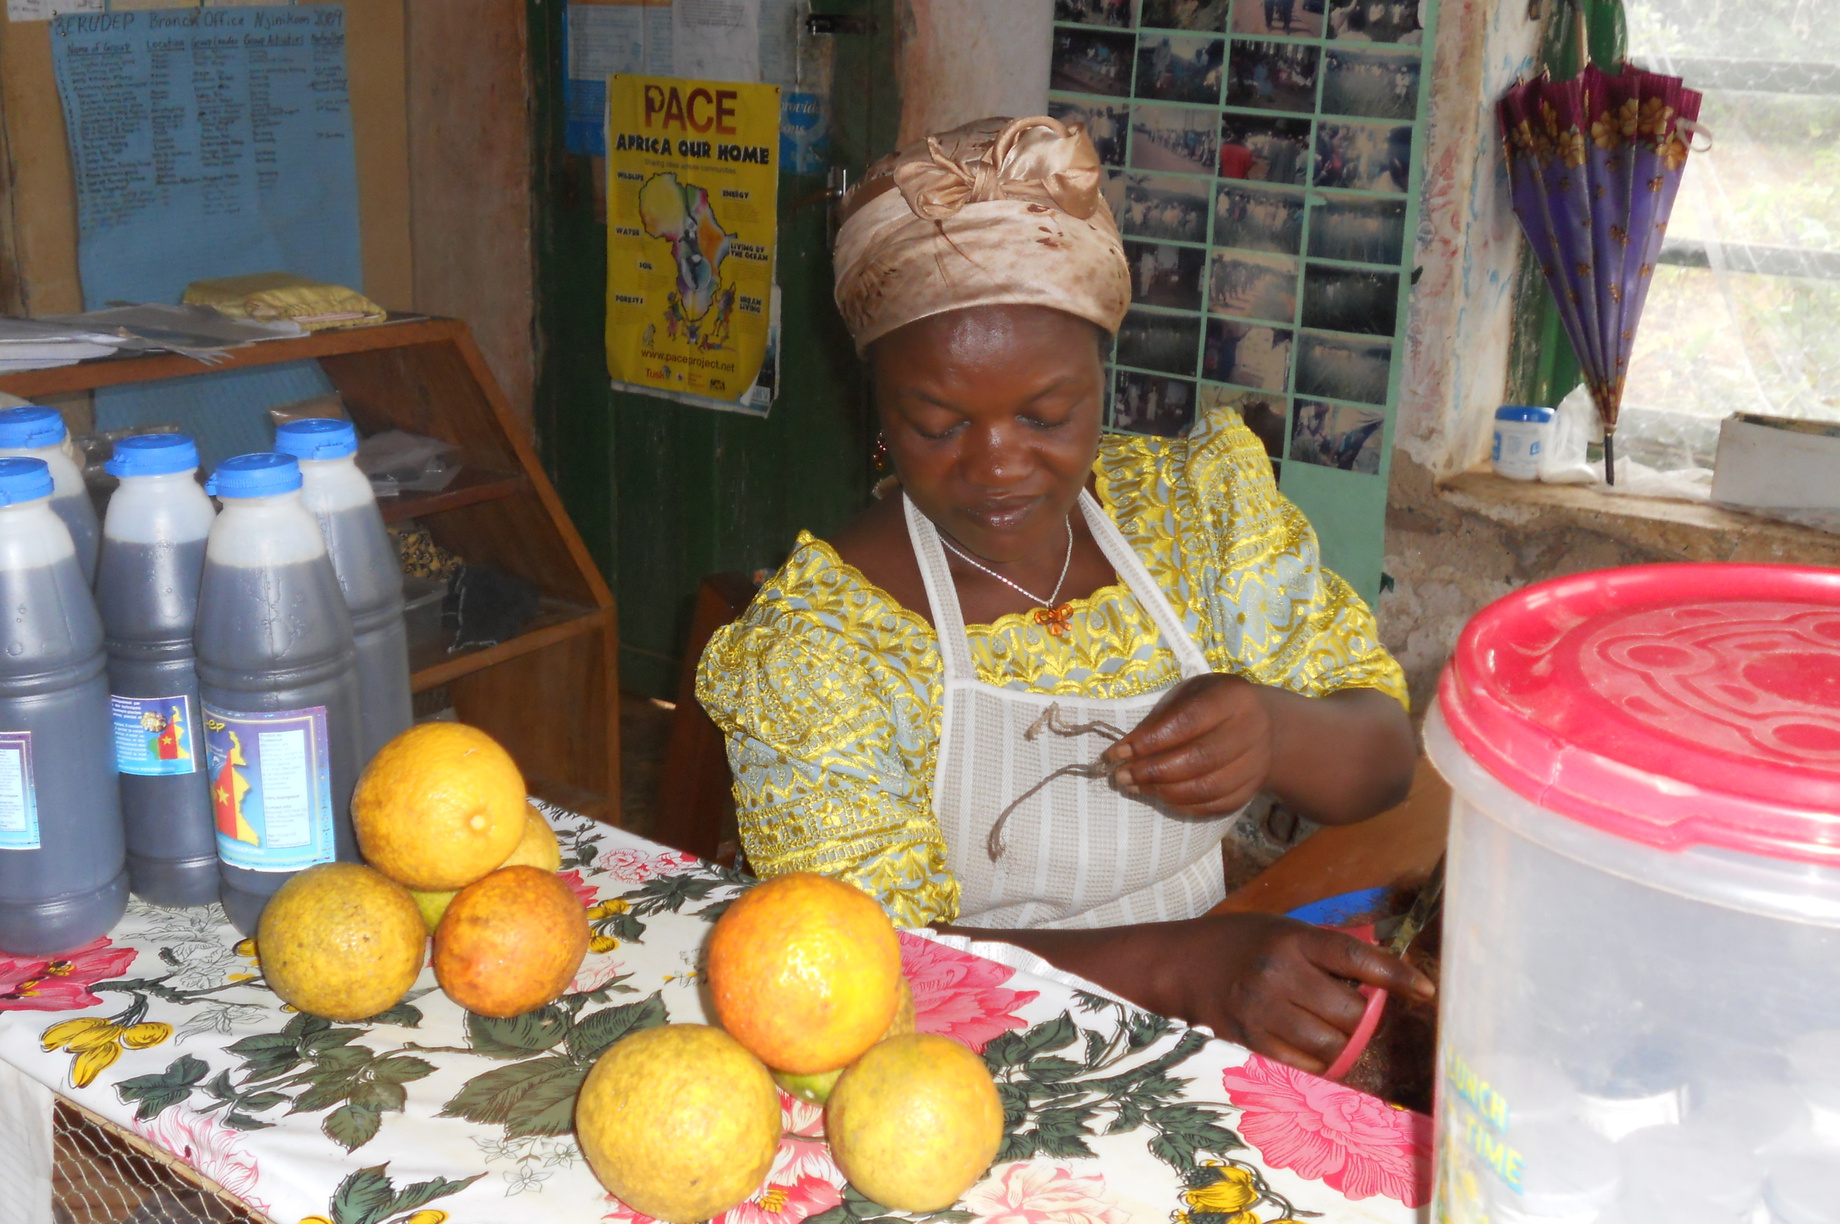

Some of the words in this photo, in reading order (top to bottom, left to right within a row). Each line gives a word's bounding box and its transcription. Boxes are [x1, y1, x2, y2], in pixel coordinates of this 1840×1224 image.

[149, 9, 200, 29] Branch
[204, 11, 244, 27] Office
[68, 42, 89, 54] Name
[92, 41, 100, 53] of
[146, 37, 185, 51] Location
[644, 85, 738, 135] PACE
[616, 132, 672, 156] AFRICA
[678, 139, 711, 159] OUR
[717, 144, 769, 165] HOME
[617, 171, 644, 182] WILDLIFE
[722, 189, 749, 199] ENERGY
[616, 227, 640, 237] WATER
[730, 242, 754, 252] LIVING
[755, 245, 765, 253] BY
[730, 250, 744, 259] THE
[745, 251, 768, 262] OCEAN
[639, 261, 652, 271] SOIL
[615, 295, 644, 305] FORESTS
[739, 296, 762, 306] URBAN
[739, 304, 761, 314] LIVING
[641, 349, 735, 373] www.paceproject.net
[646, 368, 665, 380] Tusk
[206, 719, 225, 733] ep
[1447, 1045, 1509, 1136] LUNCH
[1464, 1113, 1527, 1195] TIME
